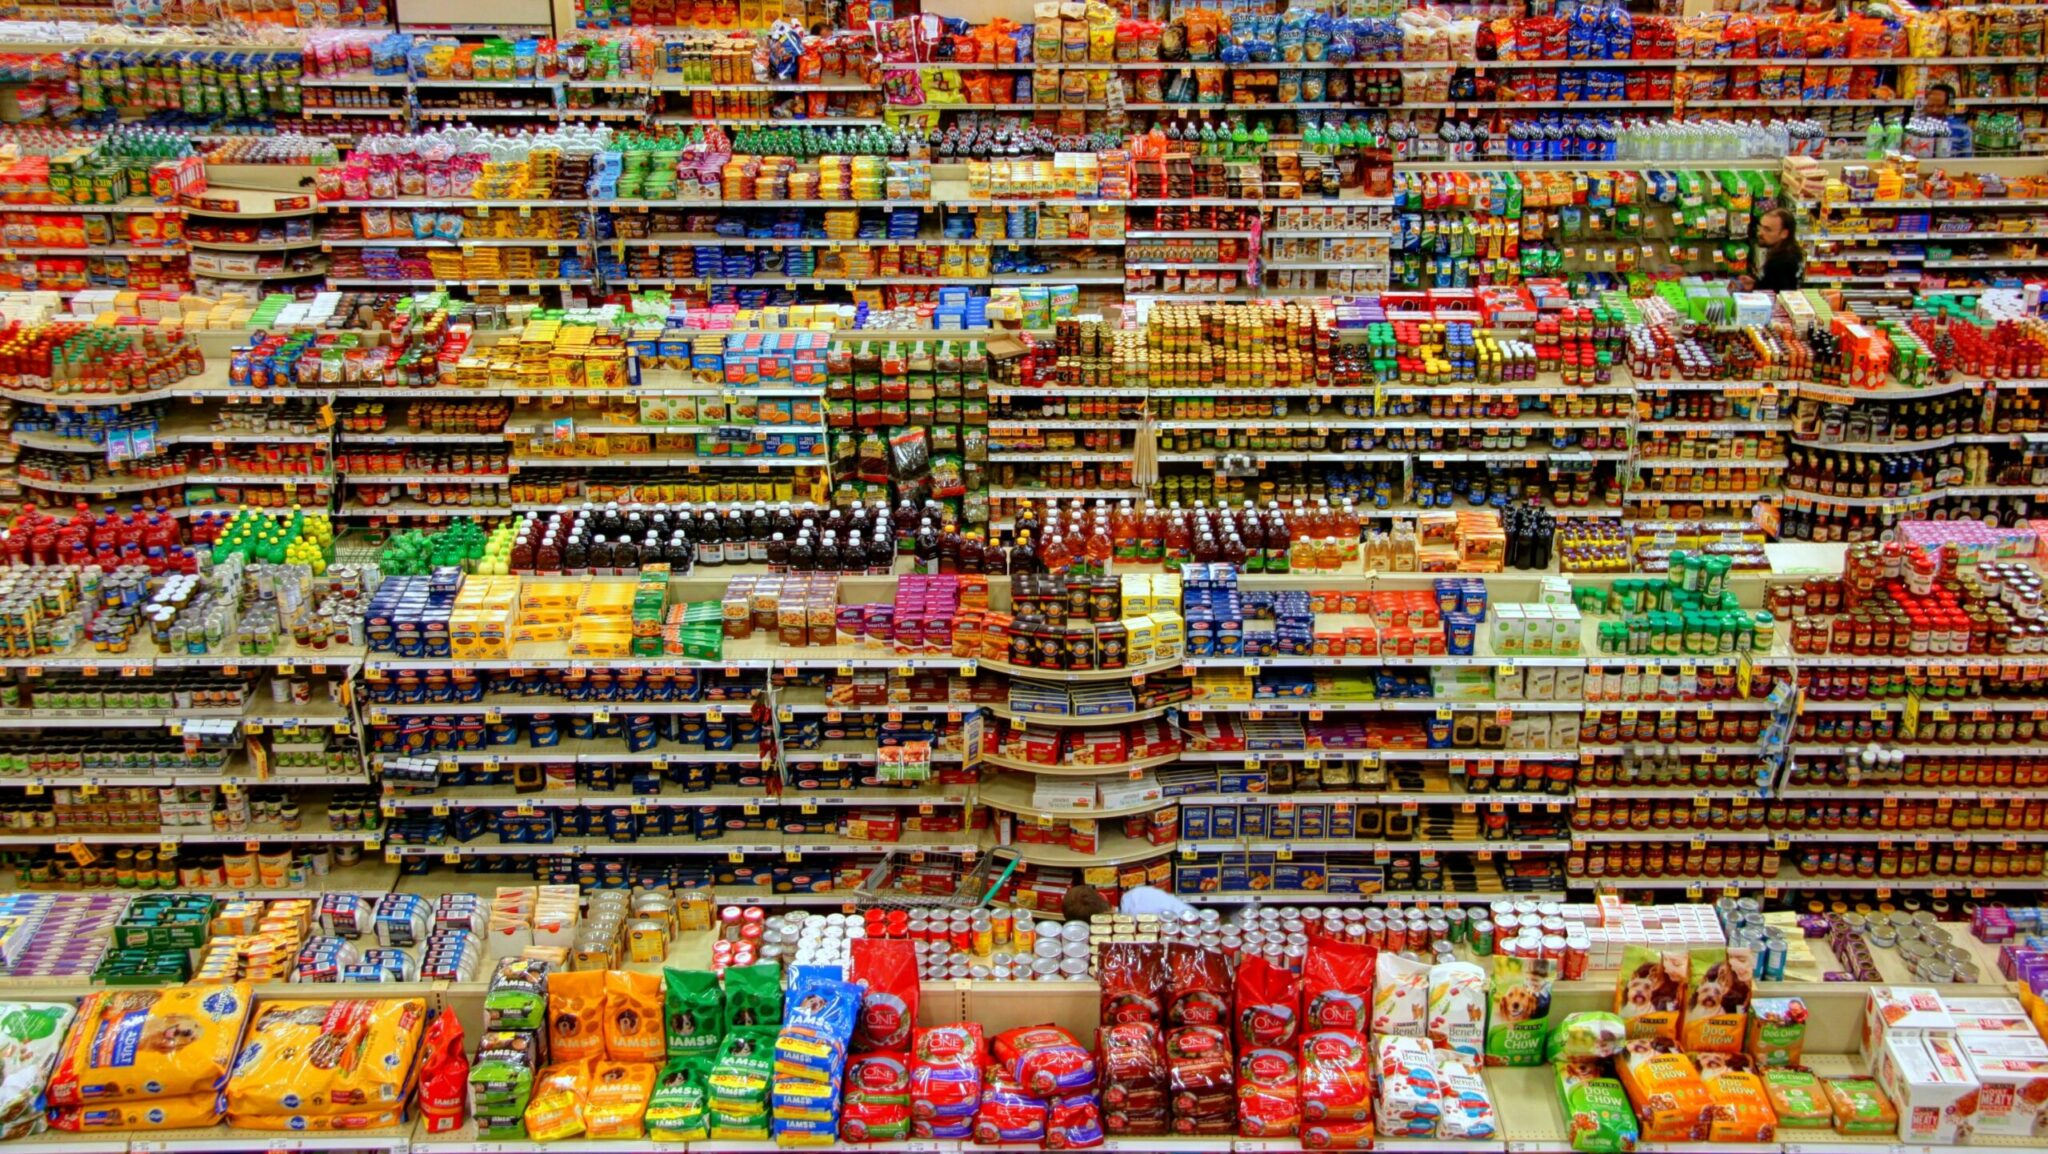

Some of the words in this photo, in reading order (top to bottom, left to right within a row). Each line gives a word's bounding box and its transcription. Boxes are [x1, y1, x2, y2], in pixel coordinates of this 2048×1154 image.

[866, 1013, 897, 1025] ONE
[1116, 1011, 1149, 1024] ONE
[1182, 1007, 1214, 1021] ONE
[1322, 1006, 1354, 1021] ONE
[1702, 1023, 1727, 1035] DOG
[669, 1035, 706, 1047] IAMS
[1505, 1030, 1532, 1041] DOG
[121, 1031, 137, 1063] ADULT
[929, 1038, 961, 1048] ONE
[1179, 1036, 1210, 1047] ONE
[1504, 1038, 1540, 1050] CHOW
[720, 1056, 757, 1067] IAMS
[784, 1051, 806, 1063] IAMS
[1253, 1060, 1285, 1071] ONE
[1653, 1070, 1688, 1080] CHOW
[655, 1086, 693, 1096] IAMS
[1584, 1086, 1610, 1097] DOG
[1719, 1086, 1756, 1096] CHOW
[784, 1096, 806, 1105] IAMS
[1585, 1095, 1622, 1107] CHOW
[1981, 1095, 2012, 1107] MEATY
[786, 1121, 808, 1129] IAMS
[1912, 1116, 1938, 1126] MEATY
